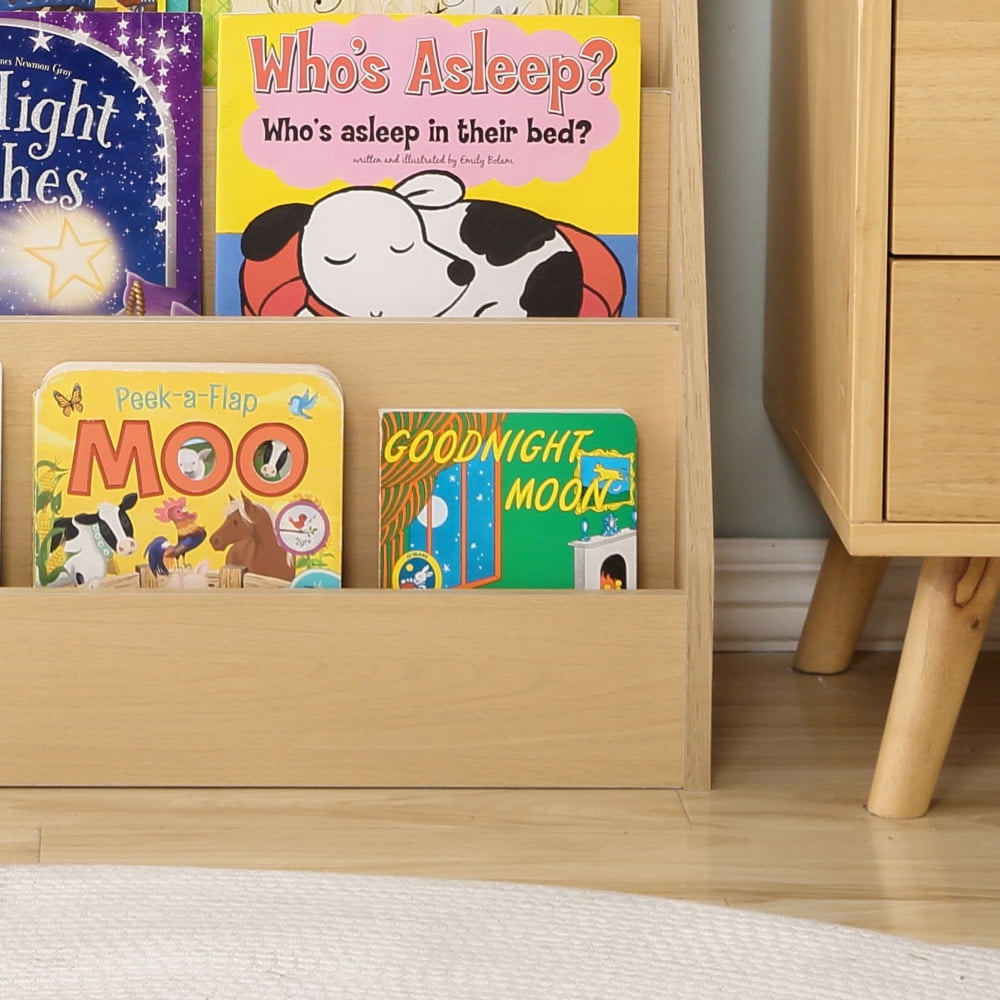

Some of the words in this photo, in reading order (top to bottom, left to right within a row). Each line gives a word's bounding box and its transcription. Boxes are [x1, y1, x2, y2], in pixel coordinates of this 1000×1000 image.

[14, 57, 50, 72] Newman
[52, 63, 73, 78] Gray
[247, 26, 391, 95] Who's
[405, 26, 619, 115] Asleep?
[262, 117, 332, 143] Who's
[341, 115, 421, 150] asleep
[429, 119, 449, 143] in
[457, 118, 519, 143] their
[527, 118, 593, 144] bed?
[353, 153, 382, 164] written
[384, 153, 400, 164] and
[401, 153, 446, 165] illustrated
[448, 153, 458, 168] by
[460, 154, 485, 169] Emily
[487, 154, 515, 165] Bolam
[115, 384, 258, 417] Peek-a-Flap
[66, 419, 309, 499] MOO
[383, 428, 595, 464] GOODNIGHT
[504, 476, 614, 512] MOON
